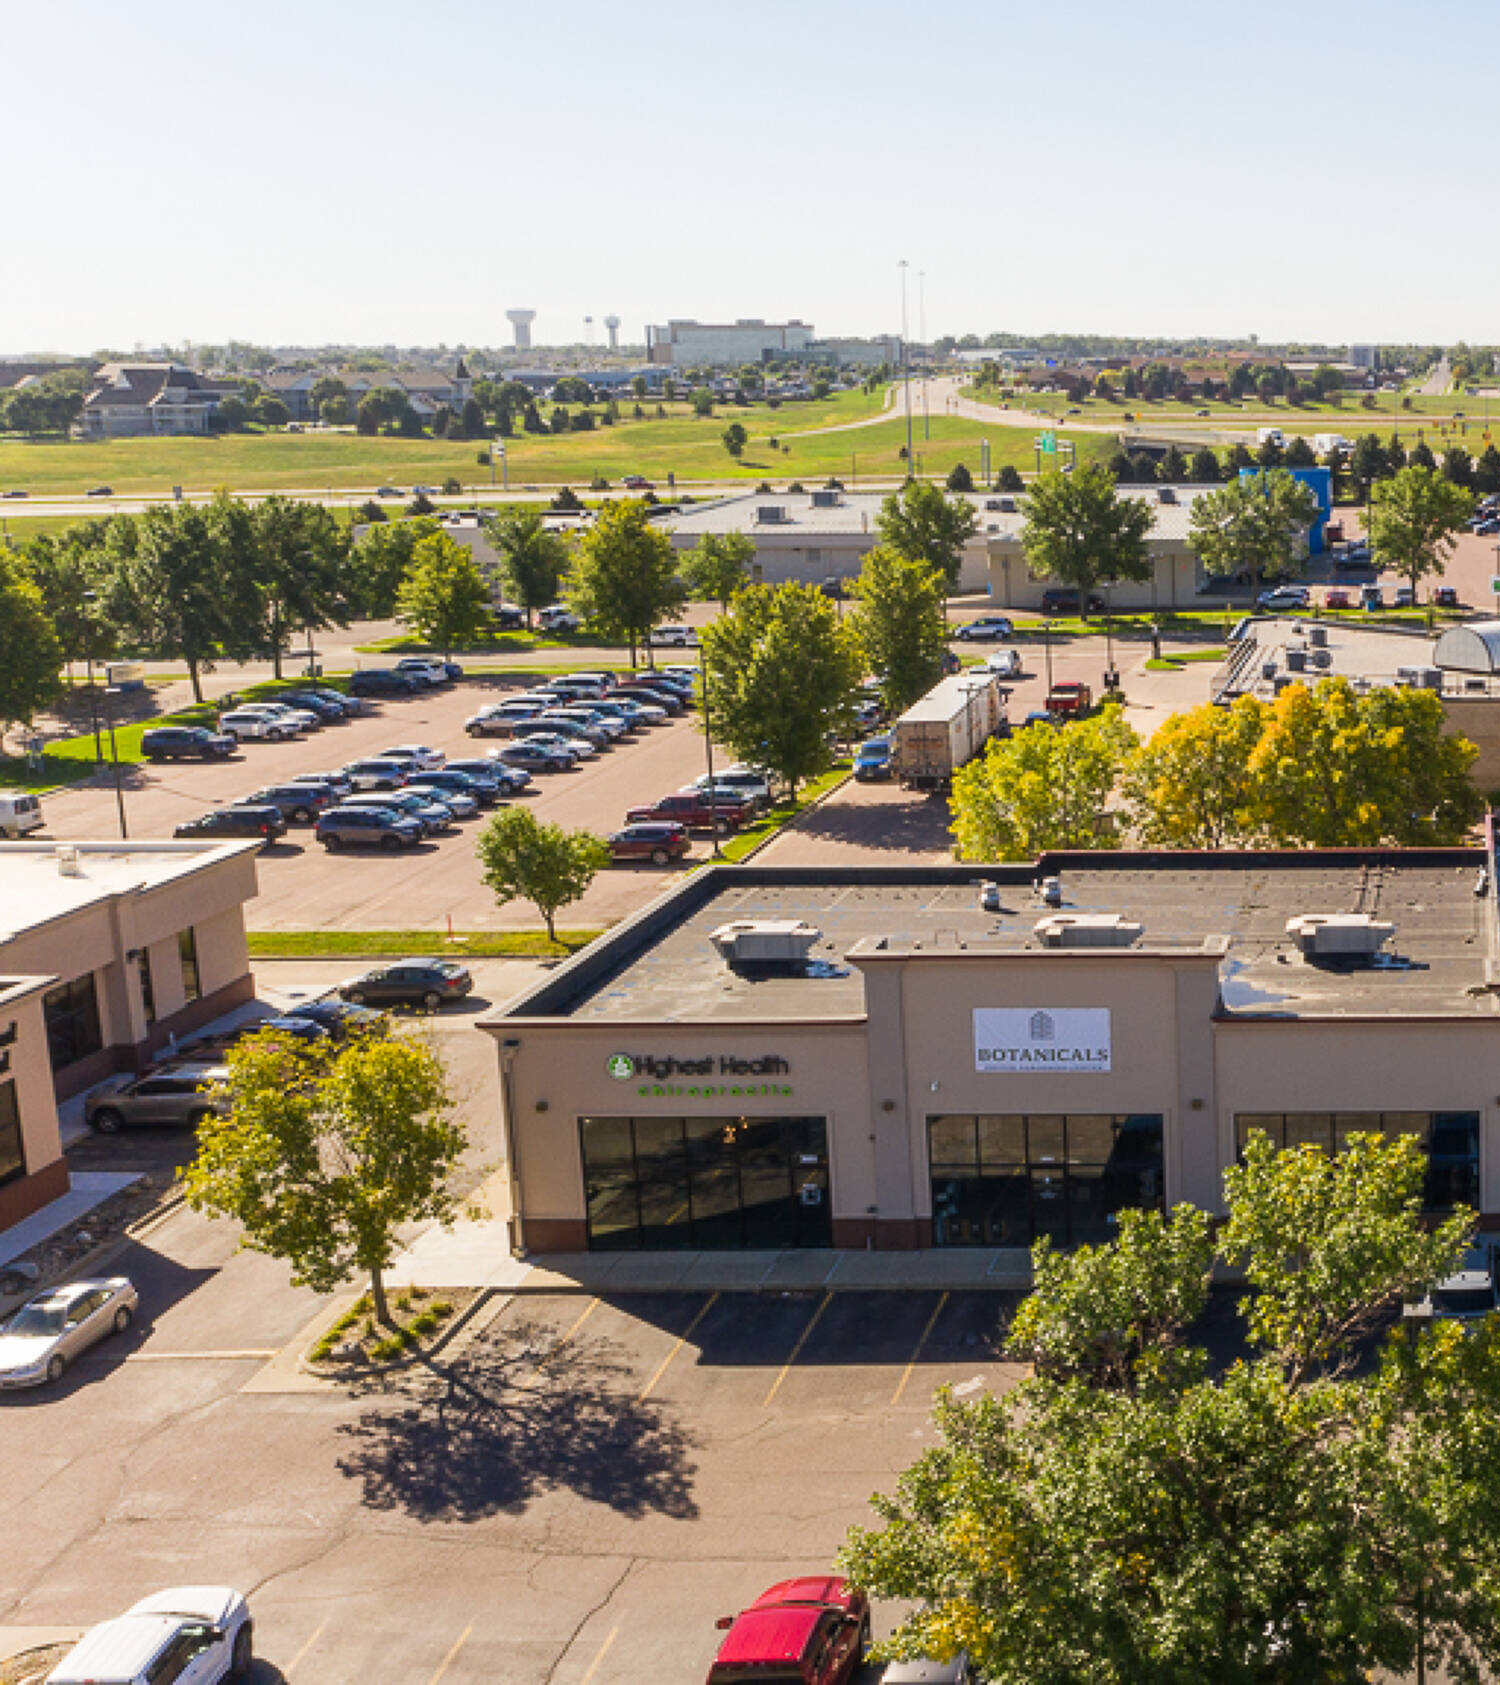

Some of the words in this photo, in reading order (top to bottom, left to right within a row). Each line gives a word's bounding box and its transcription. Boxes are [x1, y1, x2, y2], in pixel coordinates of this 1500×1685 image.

[978, 1049, 1108, 1062] BOTANICALS
[634, 1055, 714, 1080] Highest
[720, 1055, 789, 1076] Health
[637, 1084, 793, 1098] chiropractic
